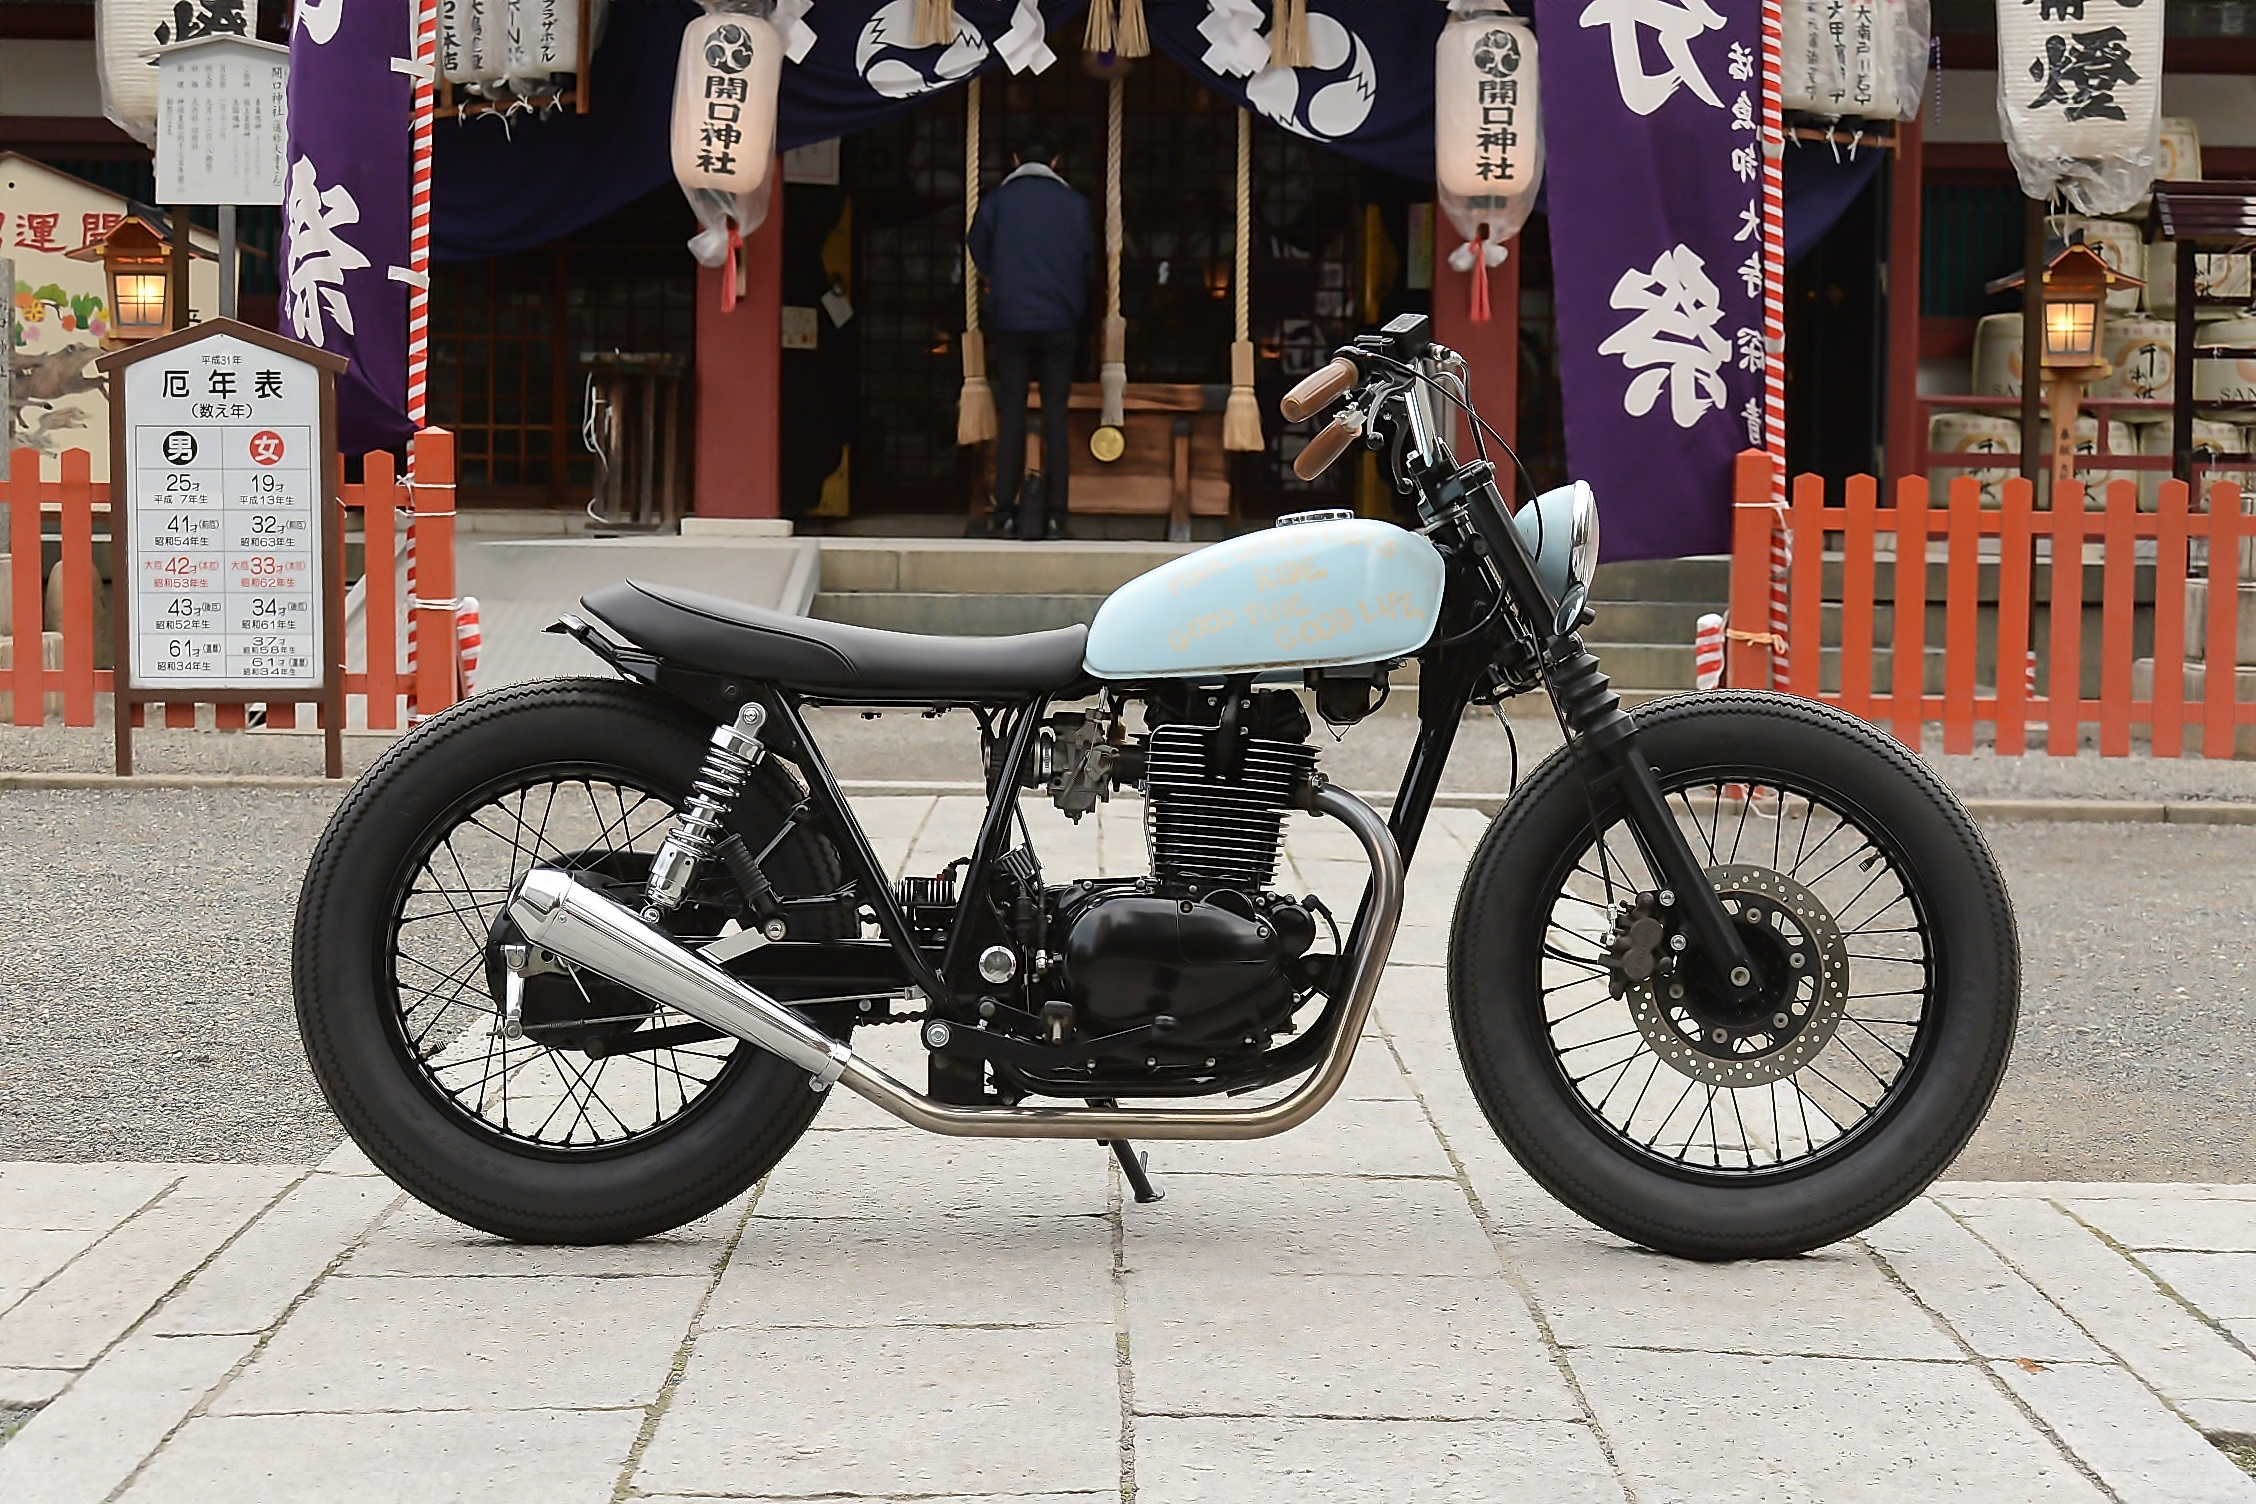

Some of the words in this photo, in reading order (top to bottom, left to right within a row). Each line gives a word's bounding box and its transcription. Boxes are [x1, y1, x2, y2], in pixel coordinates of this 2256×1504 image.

[695, 75, 749, 175] 開口神社
[1475, 79, 1518, 181] 開口神社
[201, 355, 242, 365] 平成31年
[162, 369, 283, 400] 厄年表
[191, 403, 253, 419] (数え年)
[167, 435, 193, 461] 男
[253, 435, 279, 461] 女
[166, 474, 201, 492] 25才
[251, 474, 284, 492] 19才
[239, 495, 295, 505] 平成13年生
[154, 536, 209, 546] 昭和54年生
[240, 537, 295, 547] 昭和63年生
[153, 578, 209, 588] 昭和53年生
[240, 578, 295, 588] 昭和62年生
[1253, 556, 1328, 593] RIDE
[155, 620, 211, 630] 昭和52年生
[241, 620, 296, 630] 昭和61年生
[1274, 607, 1353, 650] GOOD
[1357, 591, 1426, 623] LIFE
[1168, 608, 1236, 652] GOOD
[157, 661, 211, 671] 昭和34年生
